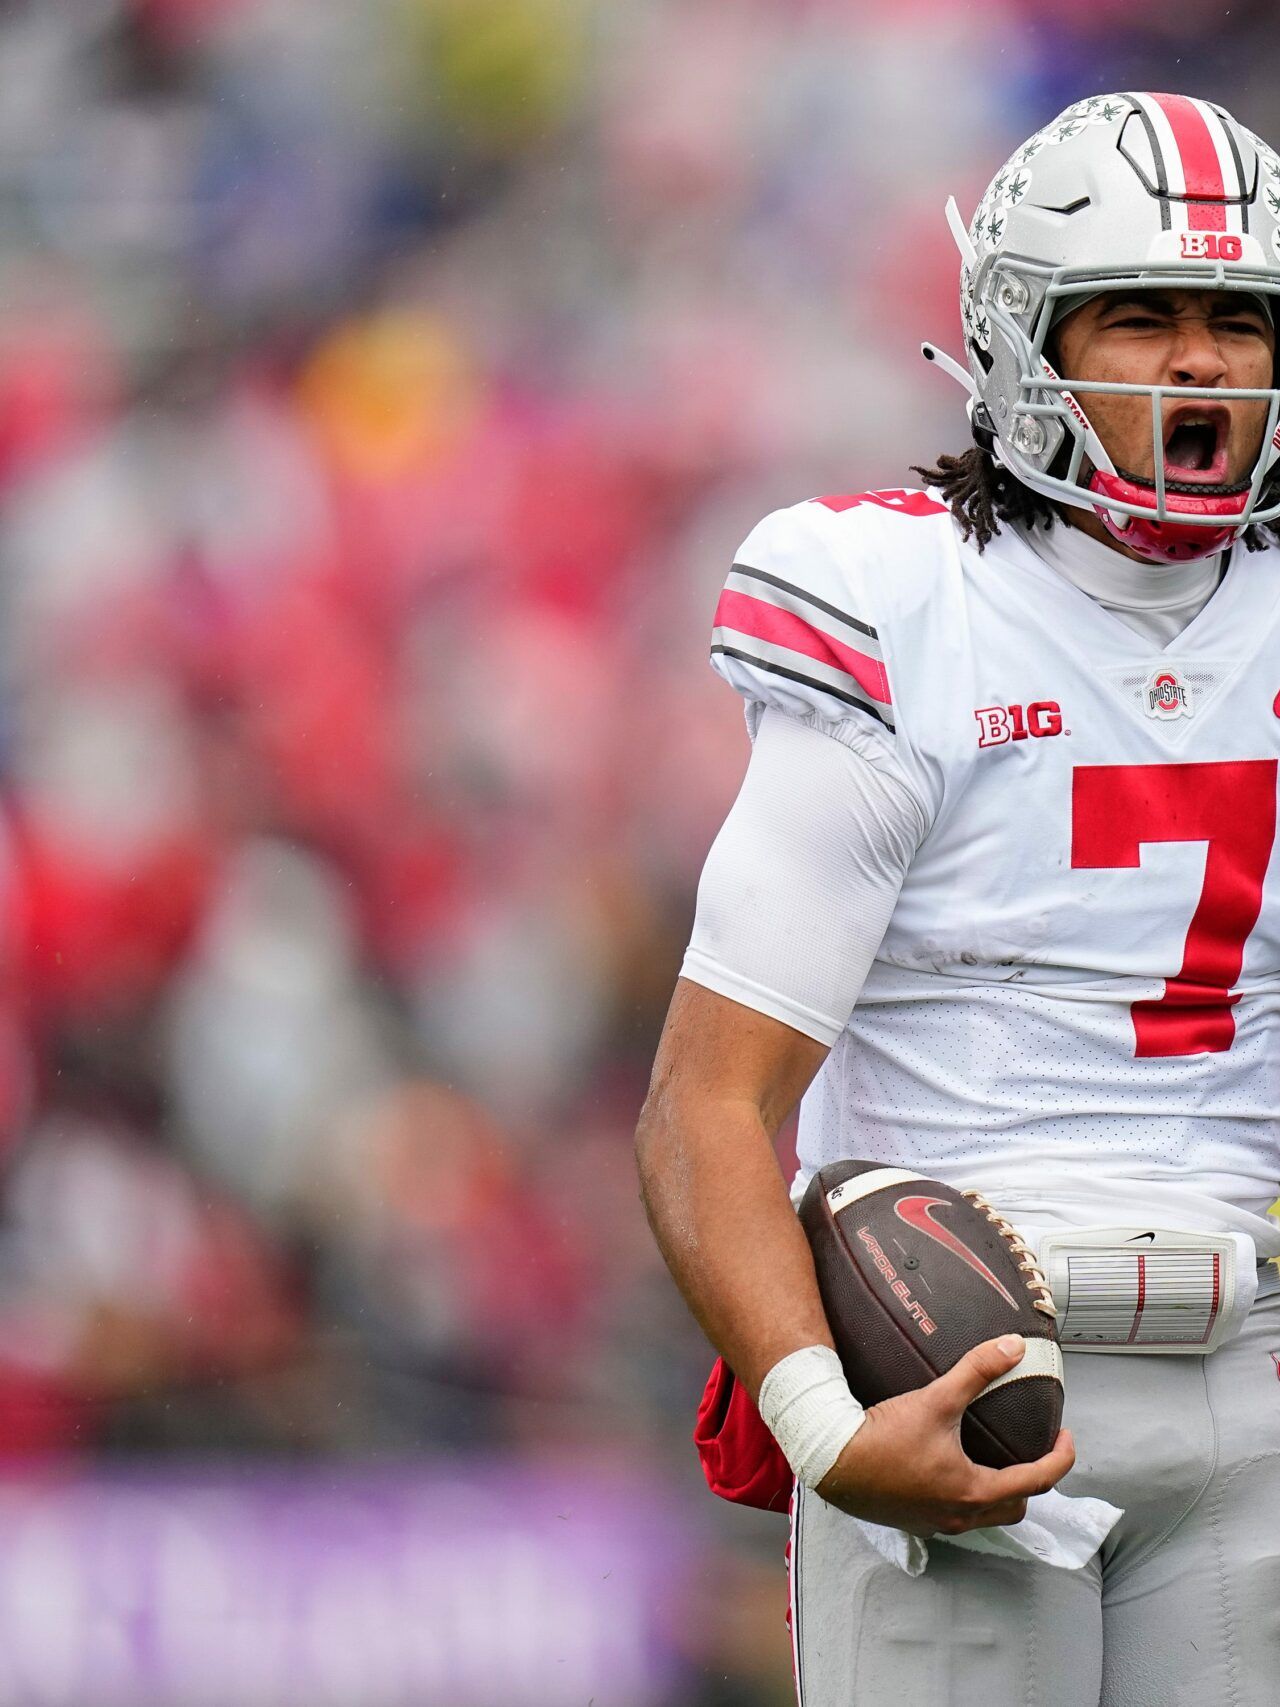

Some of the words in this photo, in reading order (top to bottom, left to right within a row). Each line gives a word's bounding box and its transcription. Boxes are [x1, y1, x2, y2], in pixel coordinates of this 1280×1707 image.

[1070, 758, 1279, 1058] 7
[857, 1225, 898, 1284] VAPOR
[890, 1279, 938, 1336] ELITE
